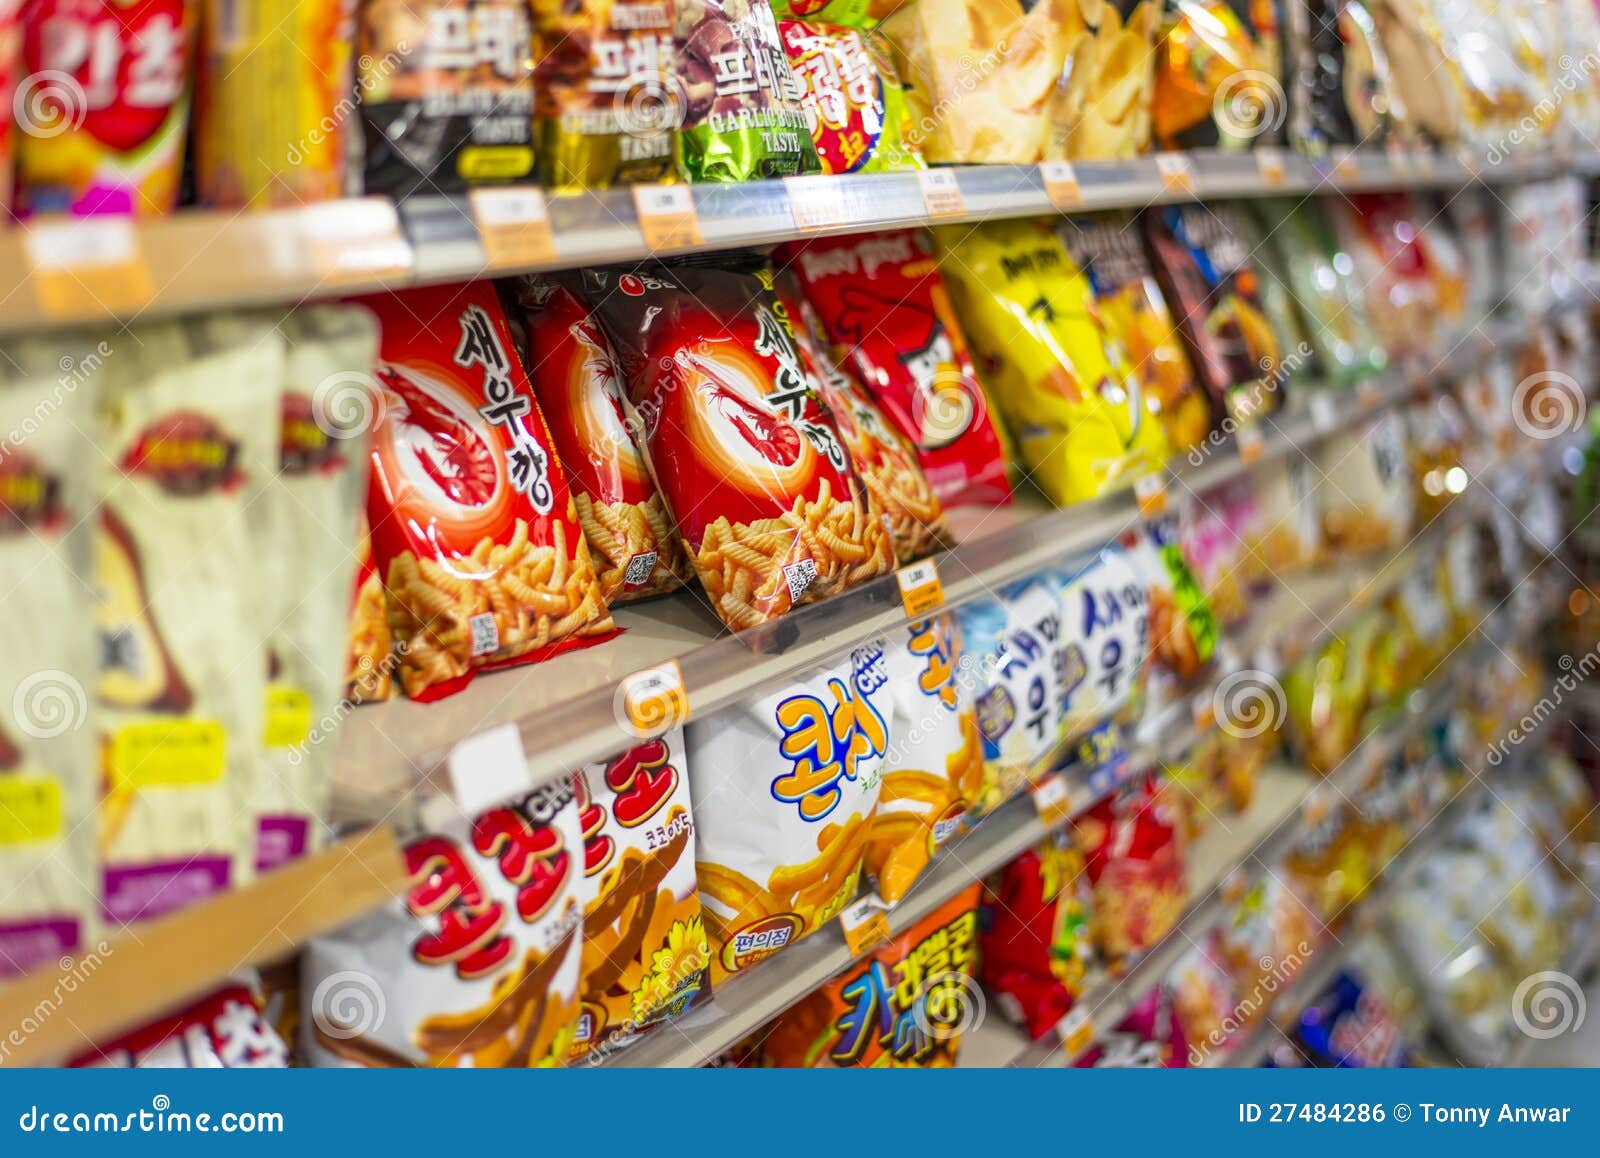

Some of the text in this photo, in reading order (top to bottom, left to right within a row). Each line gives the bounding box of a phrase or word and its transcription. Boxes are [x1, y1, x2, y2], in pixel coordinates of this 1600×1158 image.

[709, 106, 776, 134] GARLIC
[762, 131, 800, 153] TASTE
[454, 304, 553, 514] 새우깡
[754, 304, 846, 472] 새우깡
[771, 678, 888, 822] 콘치
[735, 927, 790, 953] 편의점
